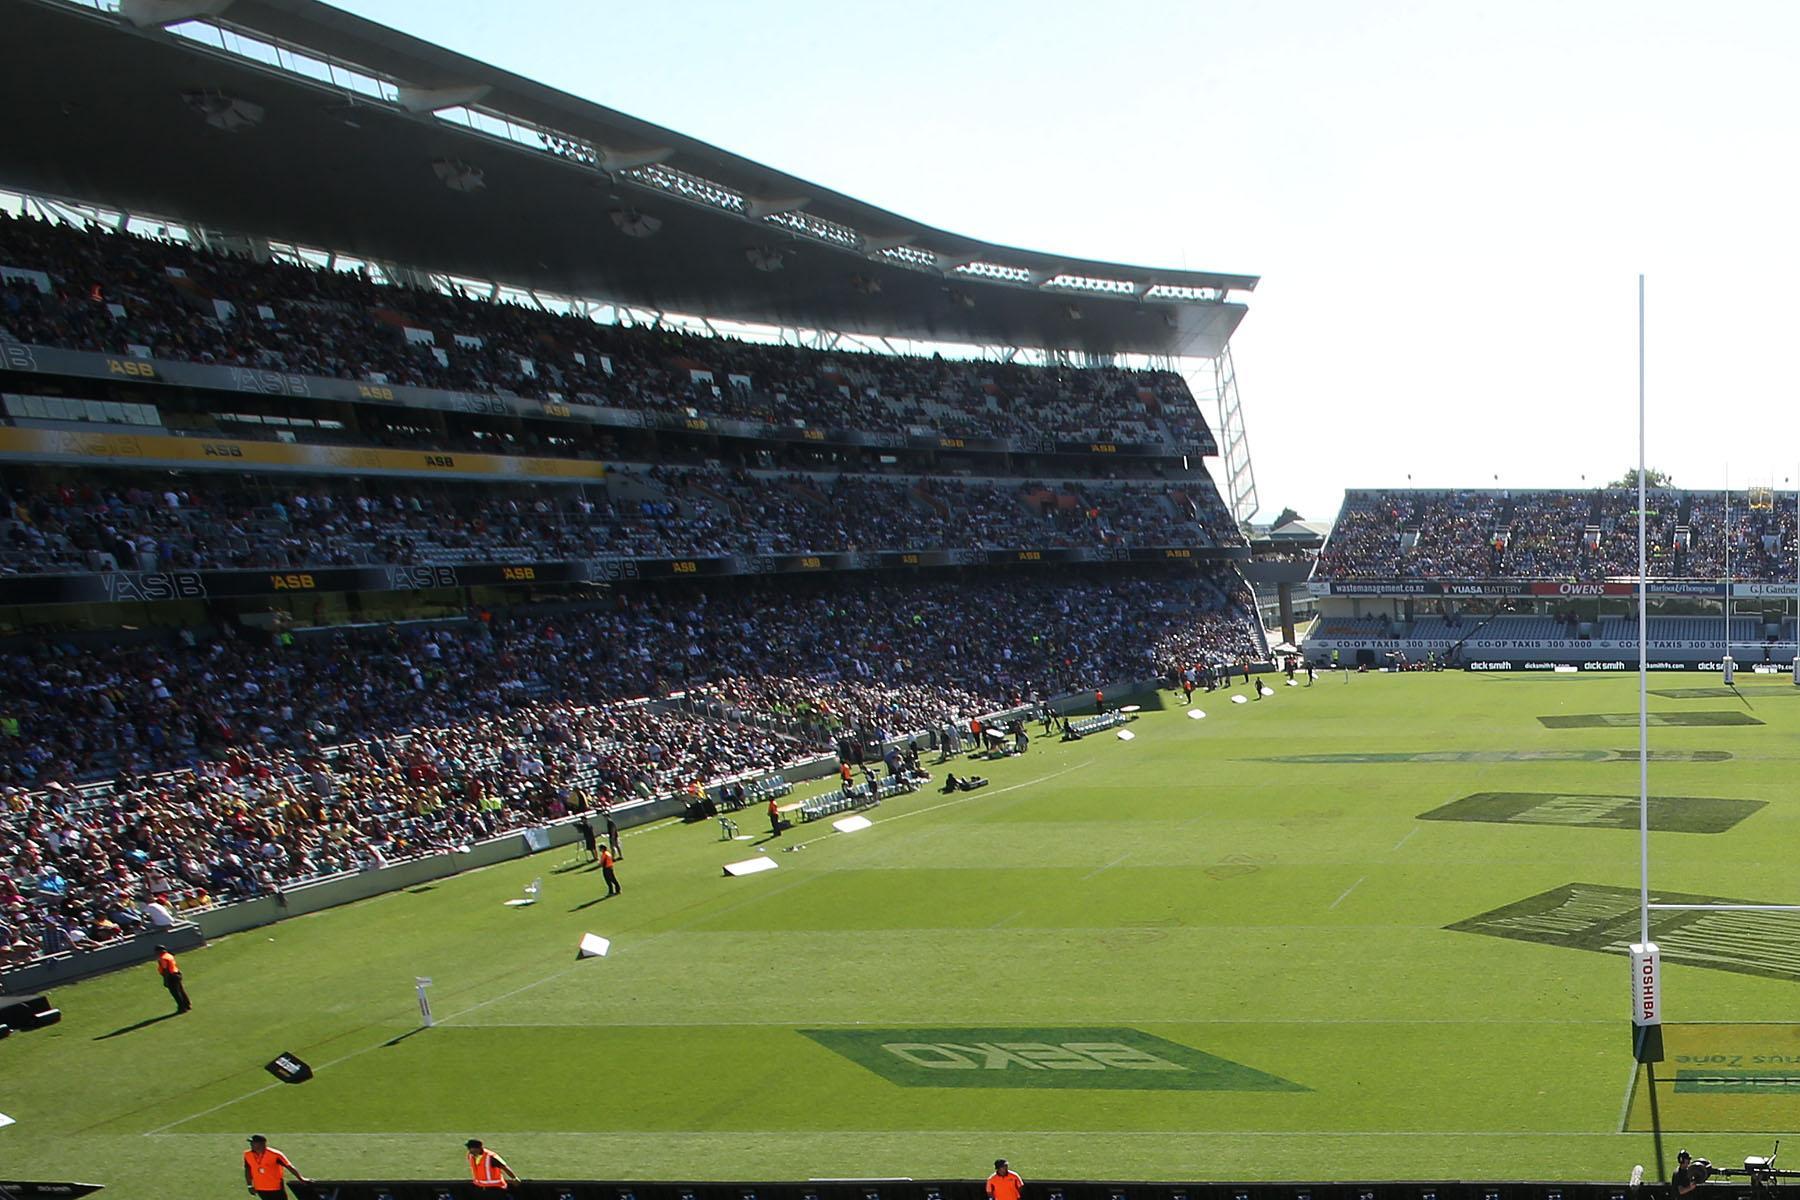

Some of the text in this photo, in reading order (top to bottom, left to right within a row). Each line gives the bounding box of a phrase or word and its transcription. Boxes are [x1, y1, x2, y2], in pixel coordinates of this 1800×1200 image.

[110, 362, 155, 377] ASB
[362, 386, 393, 400] ASB
[545, 405, 571, 417] ASB
[203, 444, 243, 457] ASB
[424, 455, 454, 467] ASB
[503, 566, 536, 580] ASB
[673, 561, 697, 573] ASB
[271, 574, 314, 589] ASB
[387, 562, 460, 590] ASB
[105, 570, 208, 601] ASB
[1336, 583, 1425, 594] wastemanagement.co.nz
[1452, 586, 1522, 595] YUASA BATTERY
[1559, 583, 1605, 595] OWENS
[1766, 586, 1798, 594] Gardner
[1470, 661, 1511, 670] dick smith
[1584, 661, 1625, 670] dick smith
[1698, 662, 1715, 670] dick
[1643, 956, 1655, 1021] TOSHIBA
[1674, 1055, 1743, 1068] Zone
